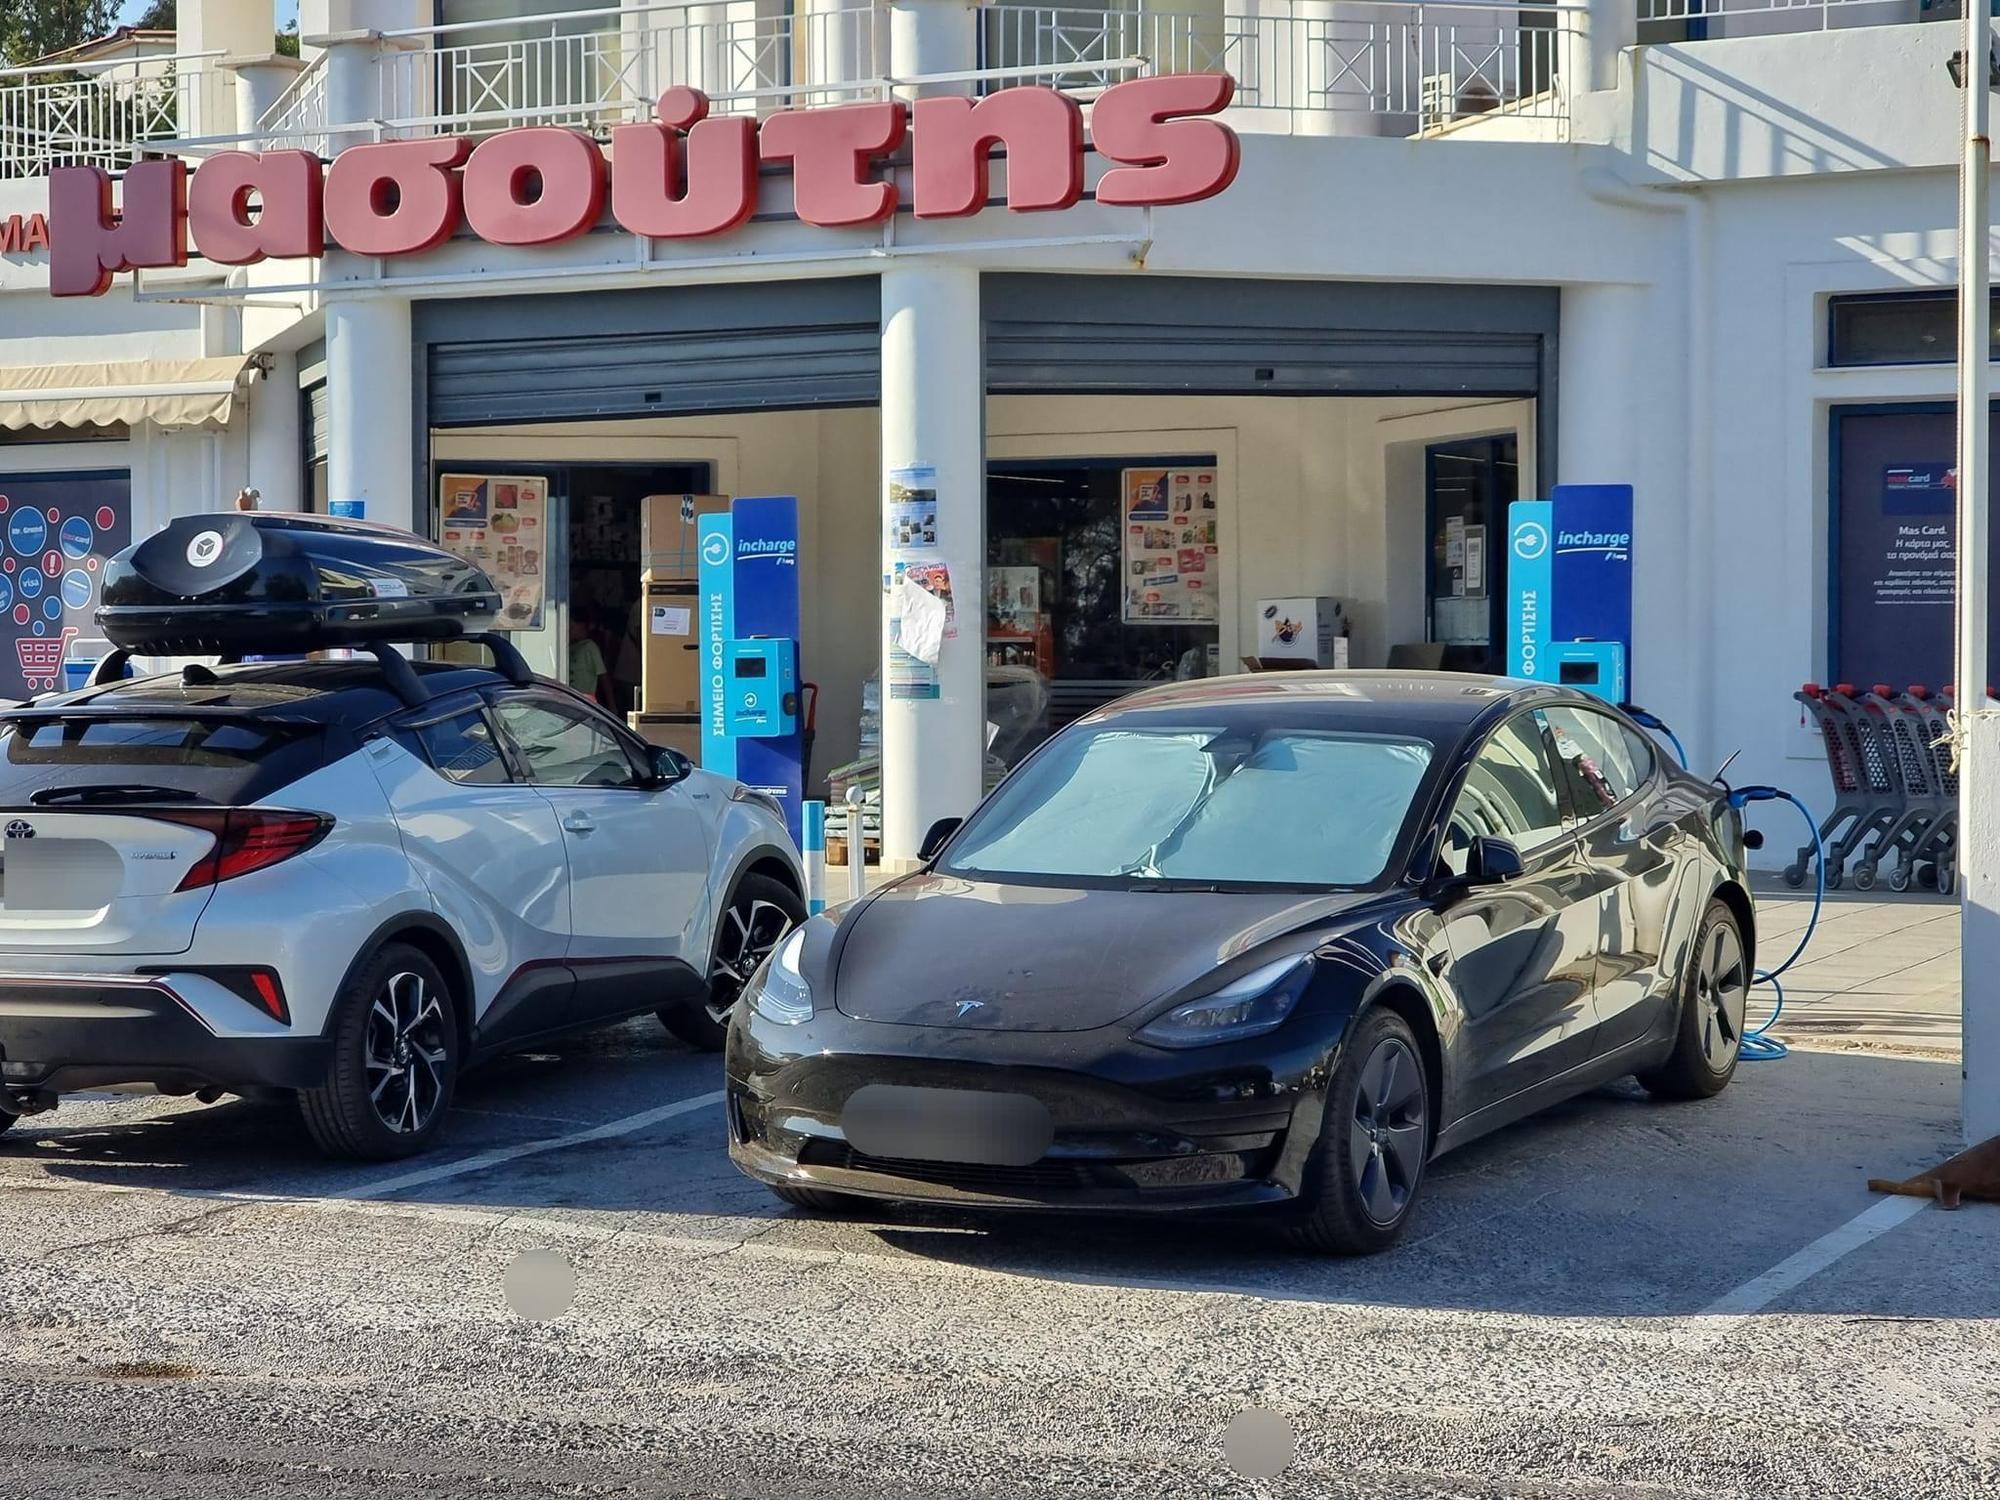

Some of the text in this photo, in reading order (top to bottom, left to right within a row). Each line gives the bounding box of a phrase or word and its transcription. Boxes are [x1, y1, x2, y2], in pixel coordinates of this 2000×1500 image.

[49, 73, 1241, 297] μασούτης
[738, 538, 796, 552] incharge
[1558, 531, 1630, 547] incharge
[1899, 526, 1920, 535] Mas
[1522, 590, 1537, 677] ΦΟΡΤΙΣΗΣ
[711, 593, 725, 736] ΣΗΜΕΙΟ ΦΟΡΤΙΣΗΣ
